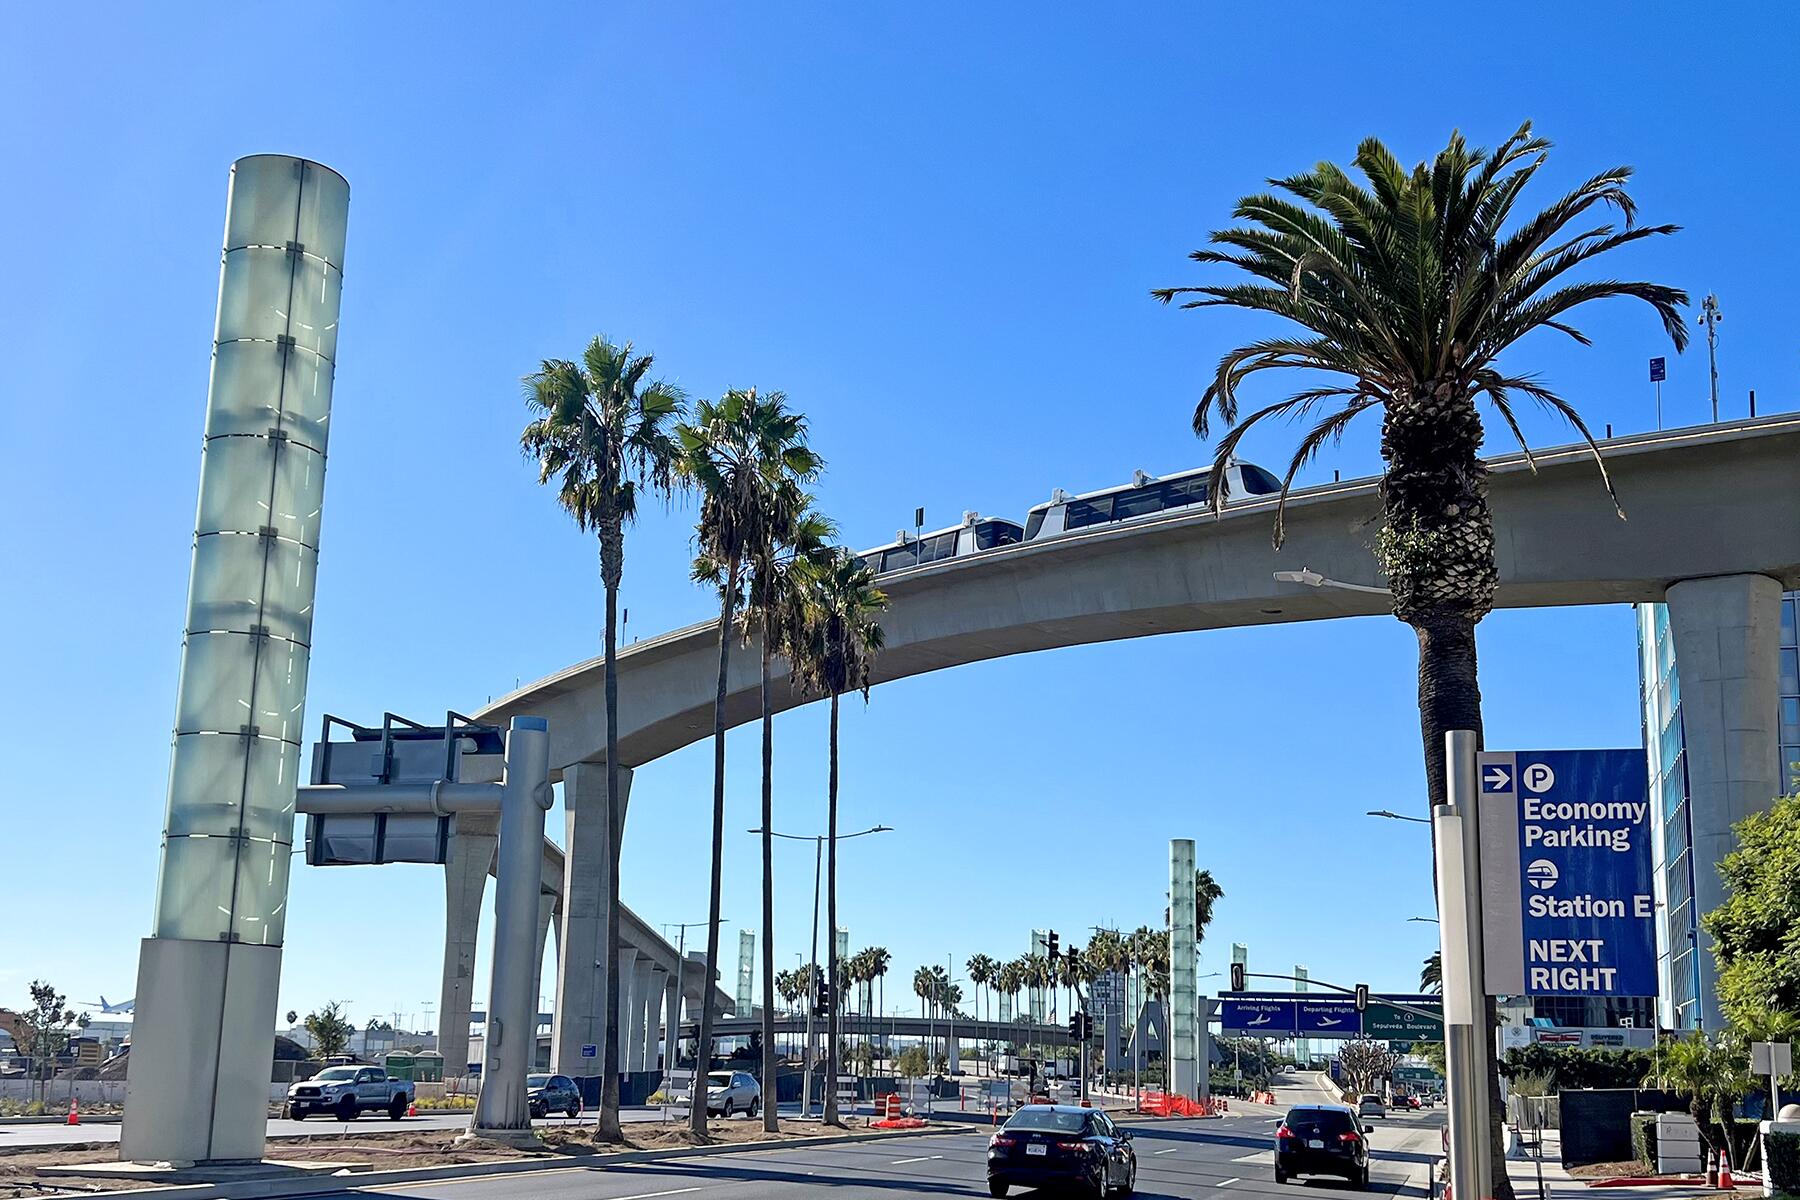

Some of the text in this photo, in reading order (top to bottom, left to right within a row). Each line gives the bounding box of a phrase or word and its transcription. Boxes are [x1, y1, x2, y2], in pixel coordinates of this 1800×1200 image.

[1524, 798, 1646, 824] Economy
[1525, 825, 1631, 851] Parking
[1529, 895, 1651, 918] Station E
[1530, 940, 1604, 963] NEXT
[1531, 968, 1617, 991] RIGHT
[1237, 1004, 1280, 1012] Arriving Flights
[1303, 1006, 1355, 1014] Departing Flights
